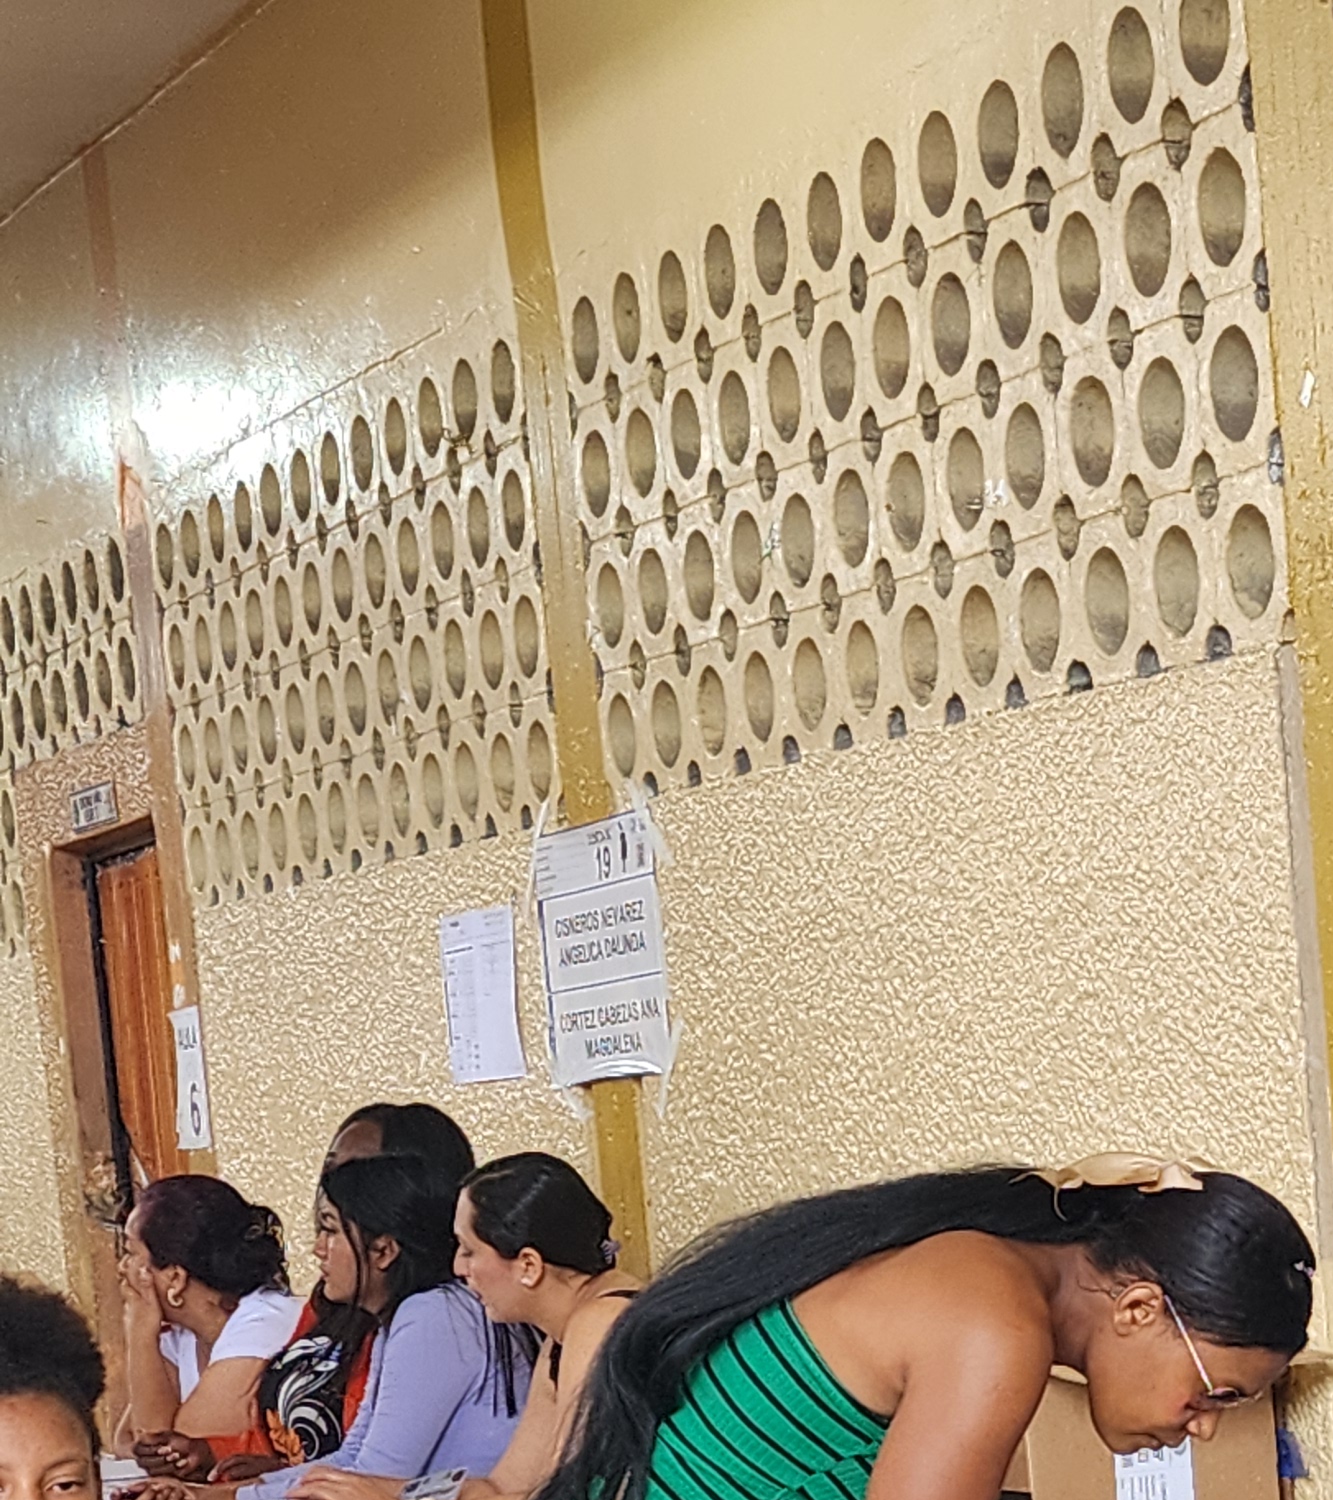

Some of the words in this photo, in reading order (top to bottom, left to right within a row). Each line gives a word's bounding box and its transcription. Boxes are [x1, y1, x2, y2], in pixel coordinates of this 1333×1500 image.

[555, 909, 600, 939] CISNEROS
[559, 939, 605, 967] ANGELICA
[560, 1008, 597, 1034] CORTEZ
[597, 1000, 640, 1028] CABEZAS
[640, 996, 662, 1020] ANA
[584, 1031, 644, 1059] MAGDALENA
